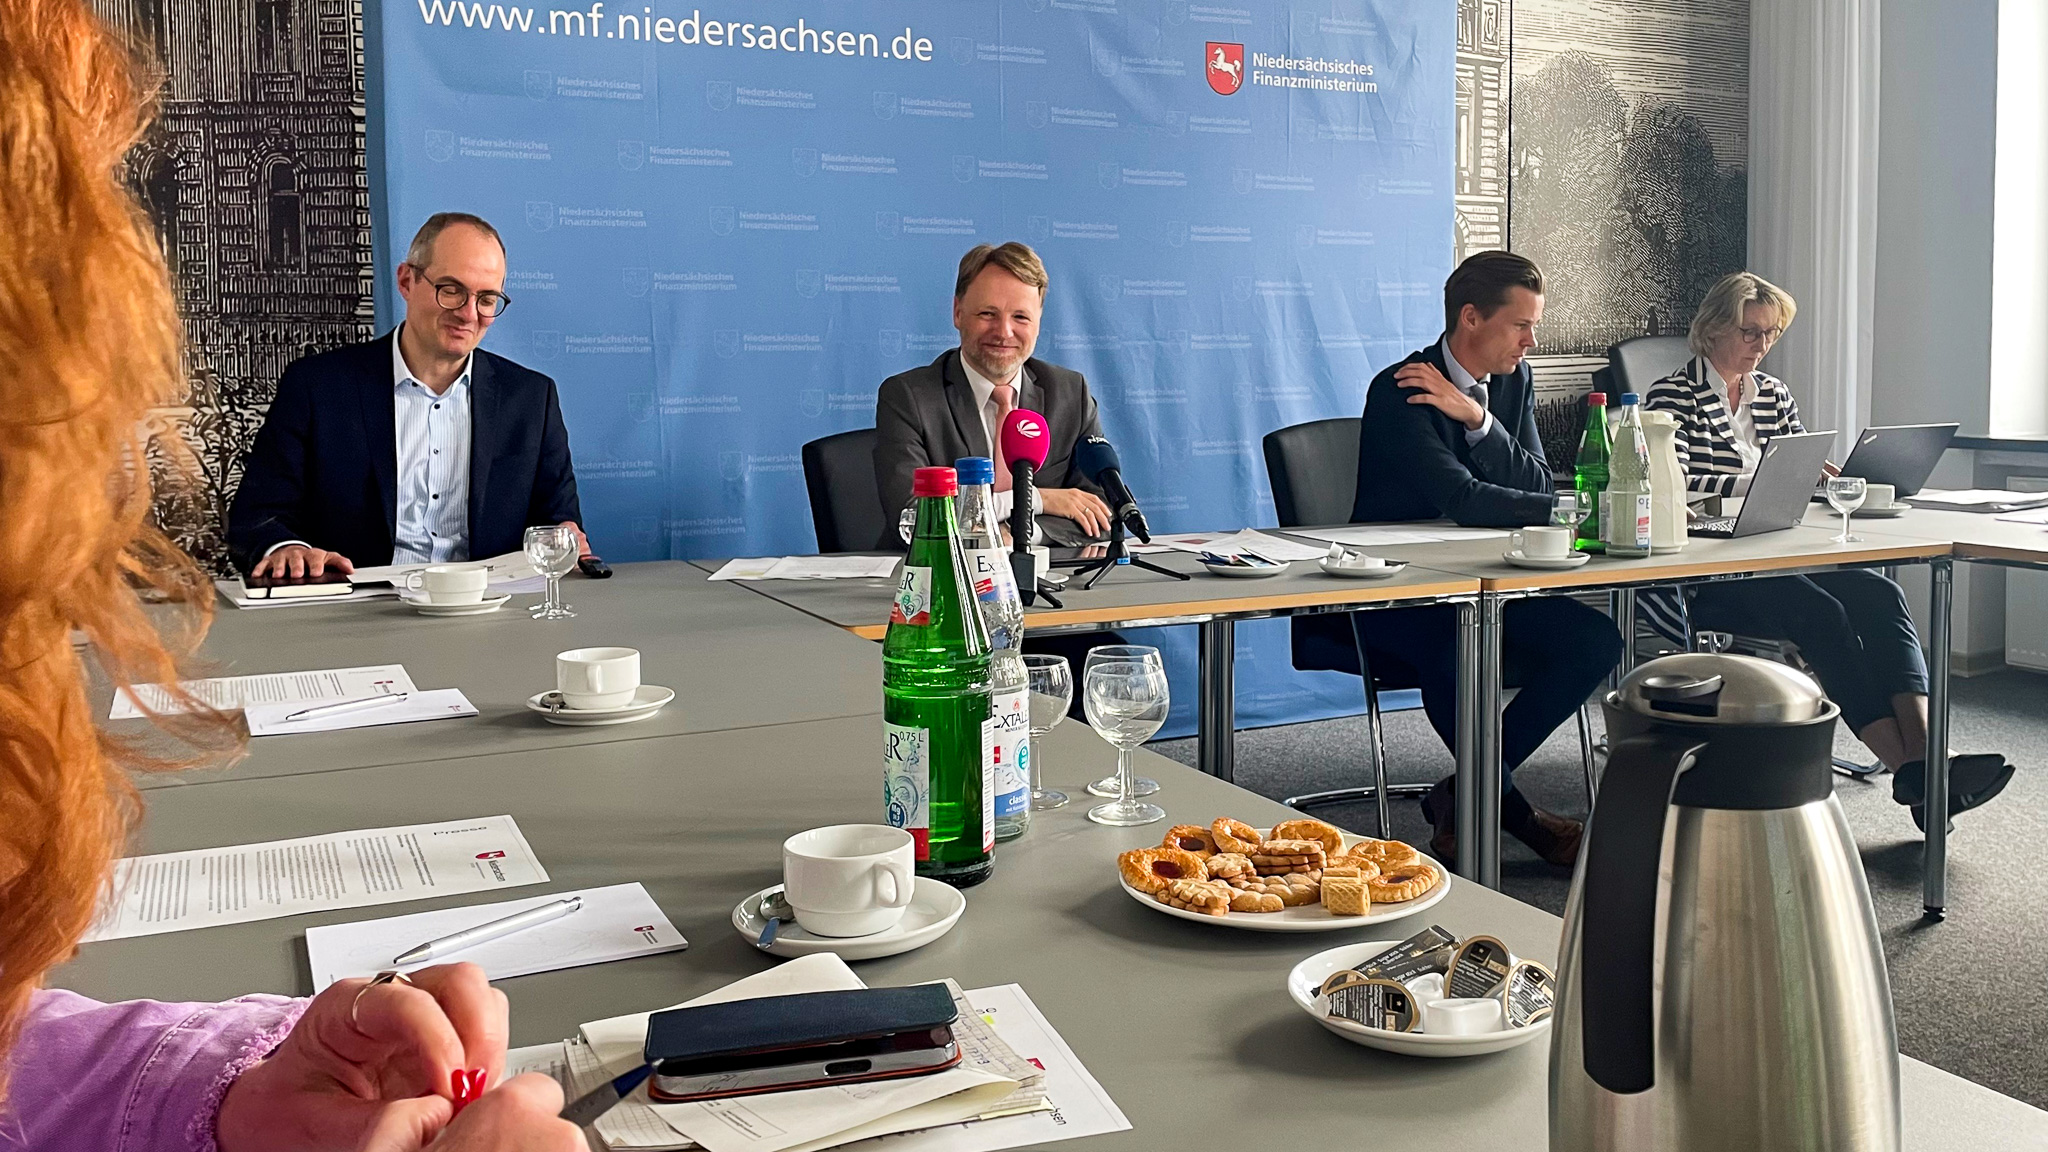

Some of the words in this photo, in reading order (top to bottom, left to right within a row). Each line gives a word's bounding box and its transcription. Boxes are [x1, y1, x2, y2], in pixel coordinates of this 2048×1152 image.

[418, 0, 933, 61] www.mf.niedersachsen.de
[1252, 52, 1374, 76] Niedersächsisches
[557, 76, 641, 90] Niedersächsisches
[1253, 71, 1378, 93] Finanzministerium
[556, 87, 644, 100] Finanzministerium
[460, 137, 549, 150] Niedersächsisches
[460, 148, 551, 160] Finanzministerium
[559, 207, 644, 218] Niedersächsisches
[559, 217, 647, 228] Finanzministerium
[654, 271, 734, 281] Niedersächsisches
[654, 281, 737, 291] Finanzministerium
